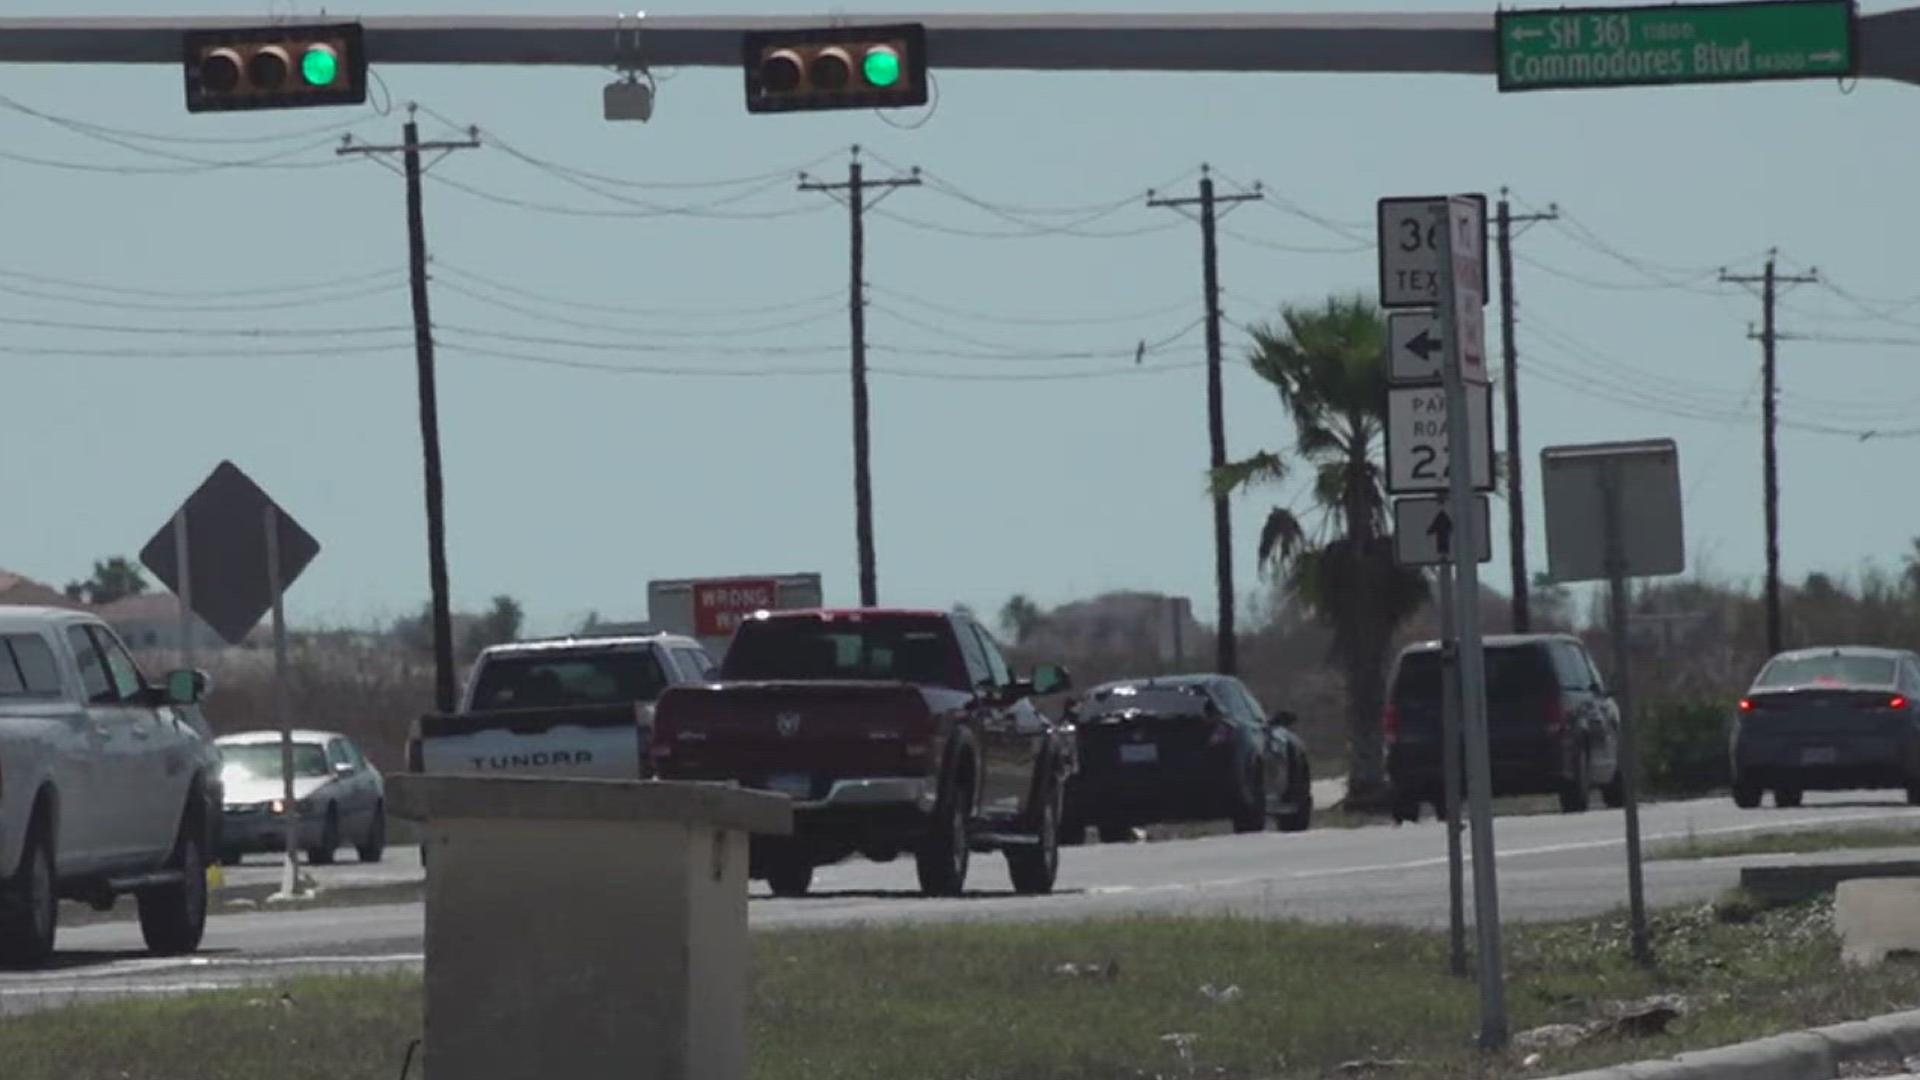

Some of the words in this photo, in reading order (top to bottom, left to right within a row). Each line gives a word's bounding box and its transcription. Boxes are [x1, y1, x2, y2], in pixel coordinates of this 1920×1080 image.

[1548, 16, 1581, 49] SH
[1590, 14, 1631, 47] 361
[1509, 46, 1683, 82] Commodores
[1693, 38, 1751, 75] Blvd
[702, 587, 769, 607] WRONG
[471, 749, 594, 769] TUNDRA
